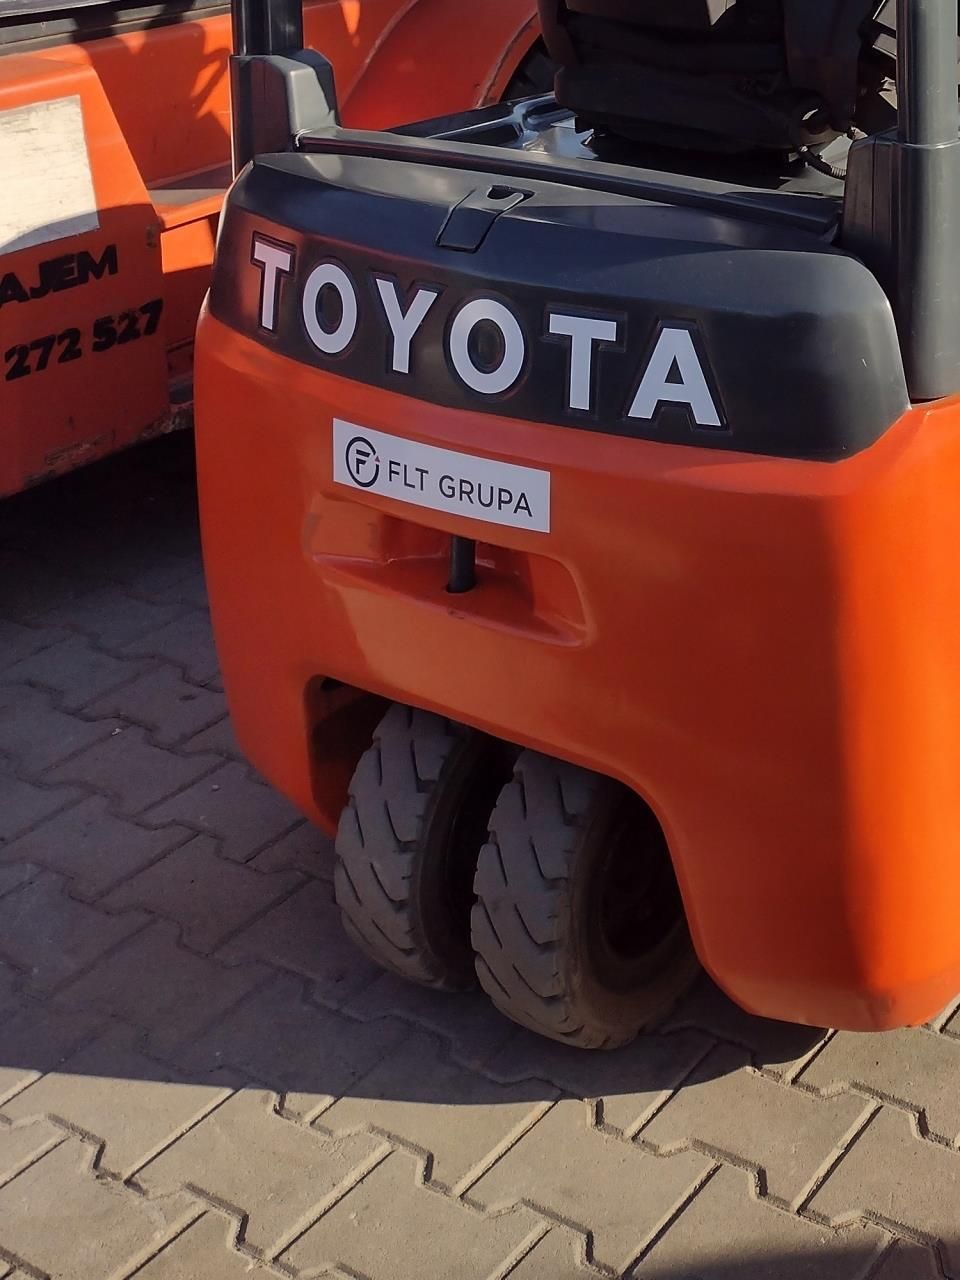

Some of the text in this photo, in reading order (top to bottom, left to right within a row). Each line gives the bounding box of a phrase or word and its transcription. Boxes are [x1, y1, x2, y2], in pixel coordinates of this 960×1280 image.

[4, 297, 164, 382] 272 527
[253, 241, 722, 428] TOYOTA
[388, 460, 430, 492] FLT
[438, 474, 533, 518] GRUPA
